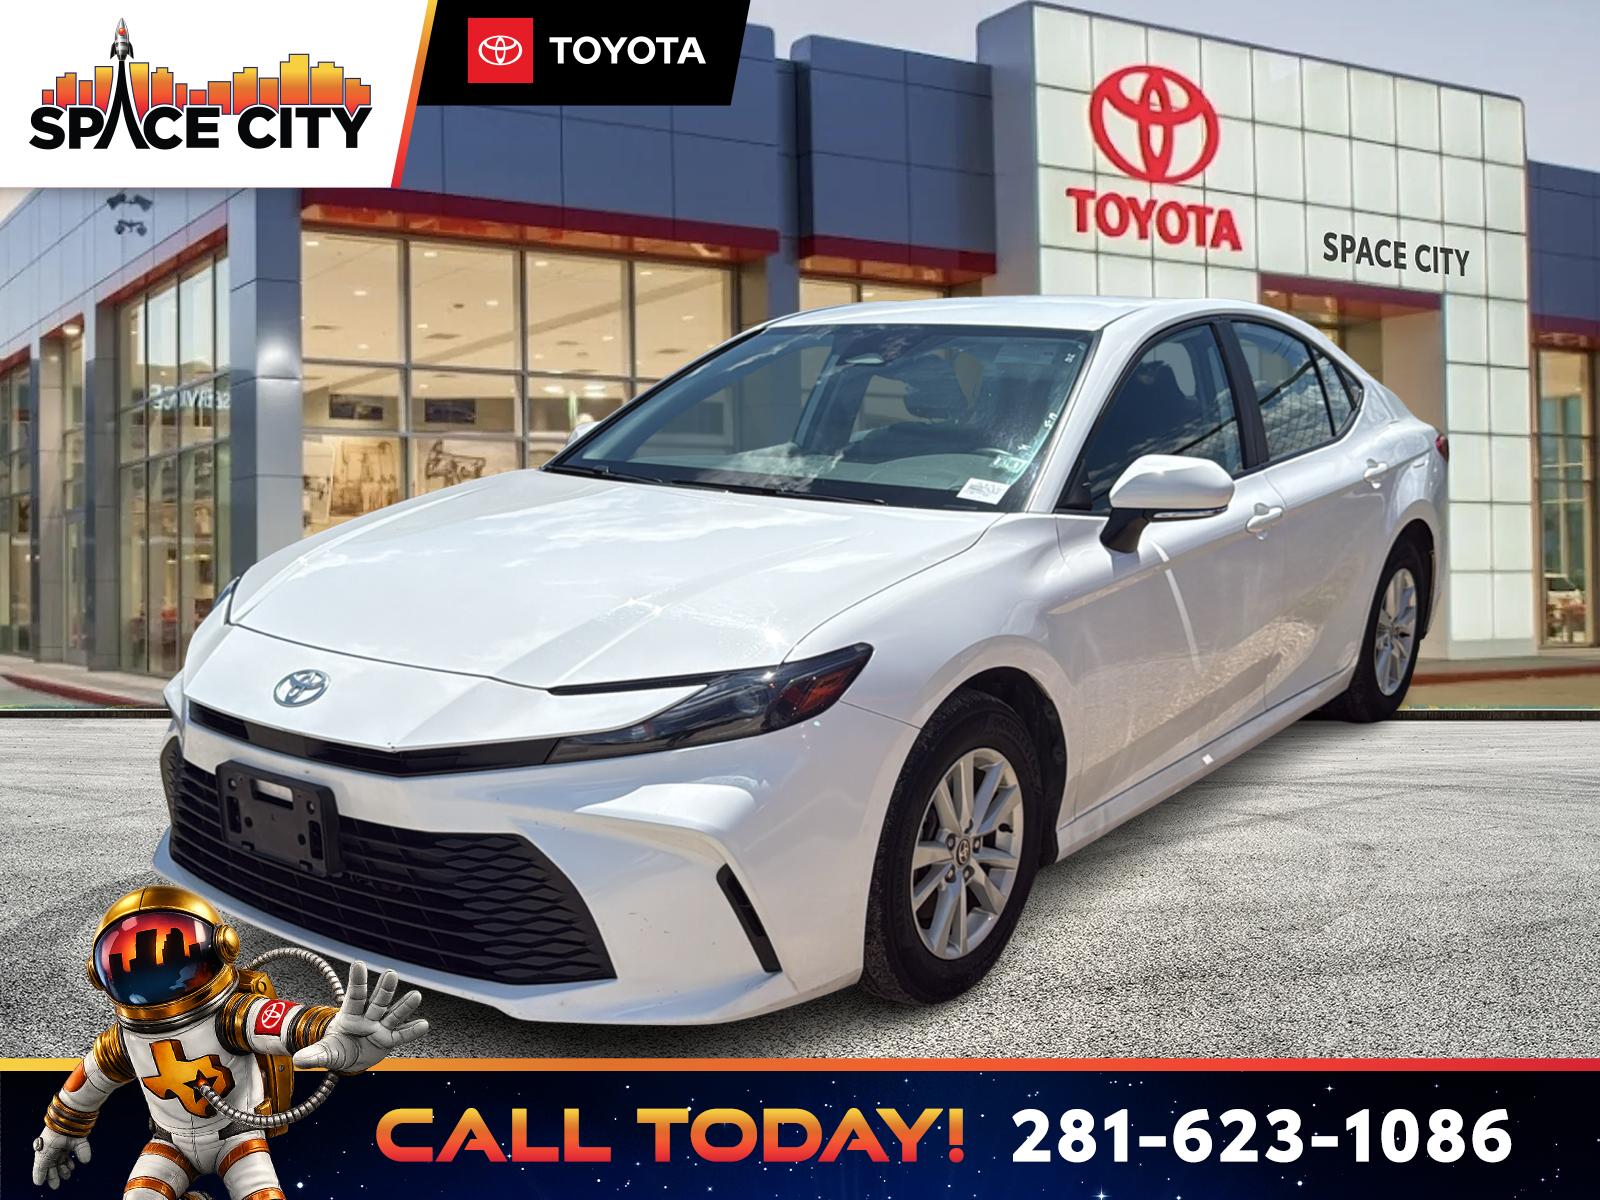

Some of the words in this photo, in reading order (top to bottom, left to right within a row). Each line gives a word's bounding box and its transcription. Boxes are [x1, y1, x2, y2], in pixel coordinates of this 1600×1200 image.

[1066, 187, 1242, 251] TOYOTA
[1322, 231, 1407, 270] SPACE
[1414, 243, 1470, 277] CITY
